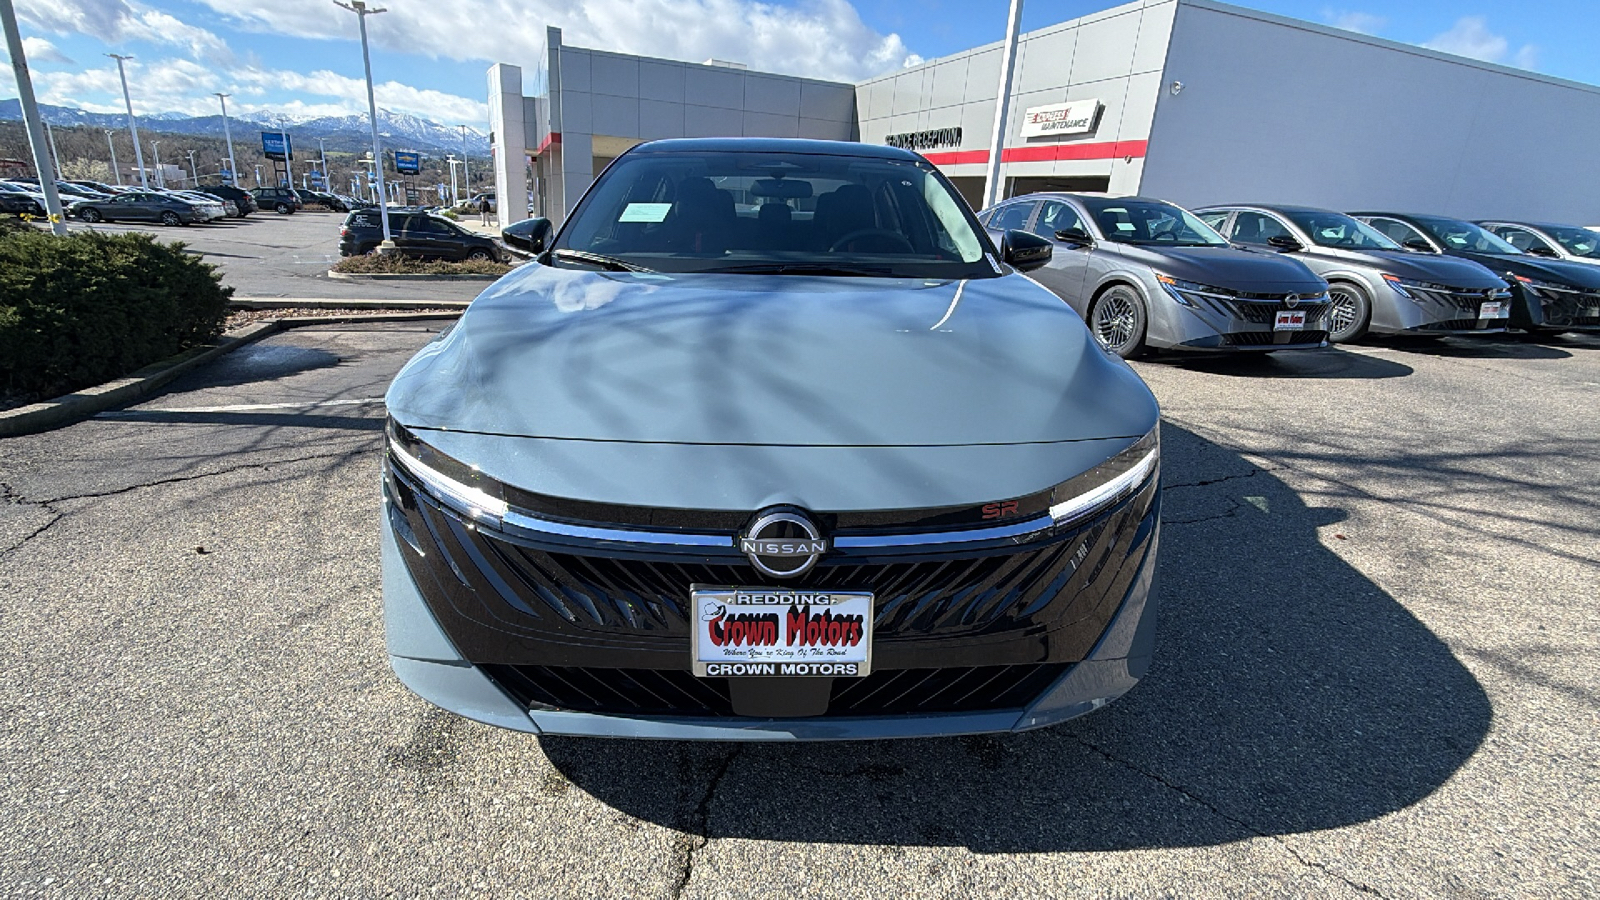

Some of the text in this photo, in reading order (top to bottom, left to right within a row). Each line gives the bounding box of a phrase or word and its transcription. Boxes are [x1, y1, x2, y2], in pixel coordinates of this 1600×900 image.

[1041, 118, 1089, 131] MAINTENANCE
[885, 133, 914, 149] SERVICE
[981, 501, 1019, 519] SR
[743, 541, 825, 553] NISSAN
[737, 595, 830, 605] REDDING
[708, 606, 863, 647] Crown Motors
[723, 648, 747, 656] Where
[775, 648, 794, 658] King
[797, 648, 808, 658] Of
[810, 648, 824, 656] The
[826, 648, 847, 656] Road
[707, 664, 858, 675] CROWN MOTORS
